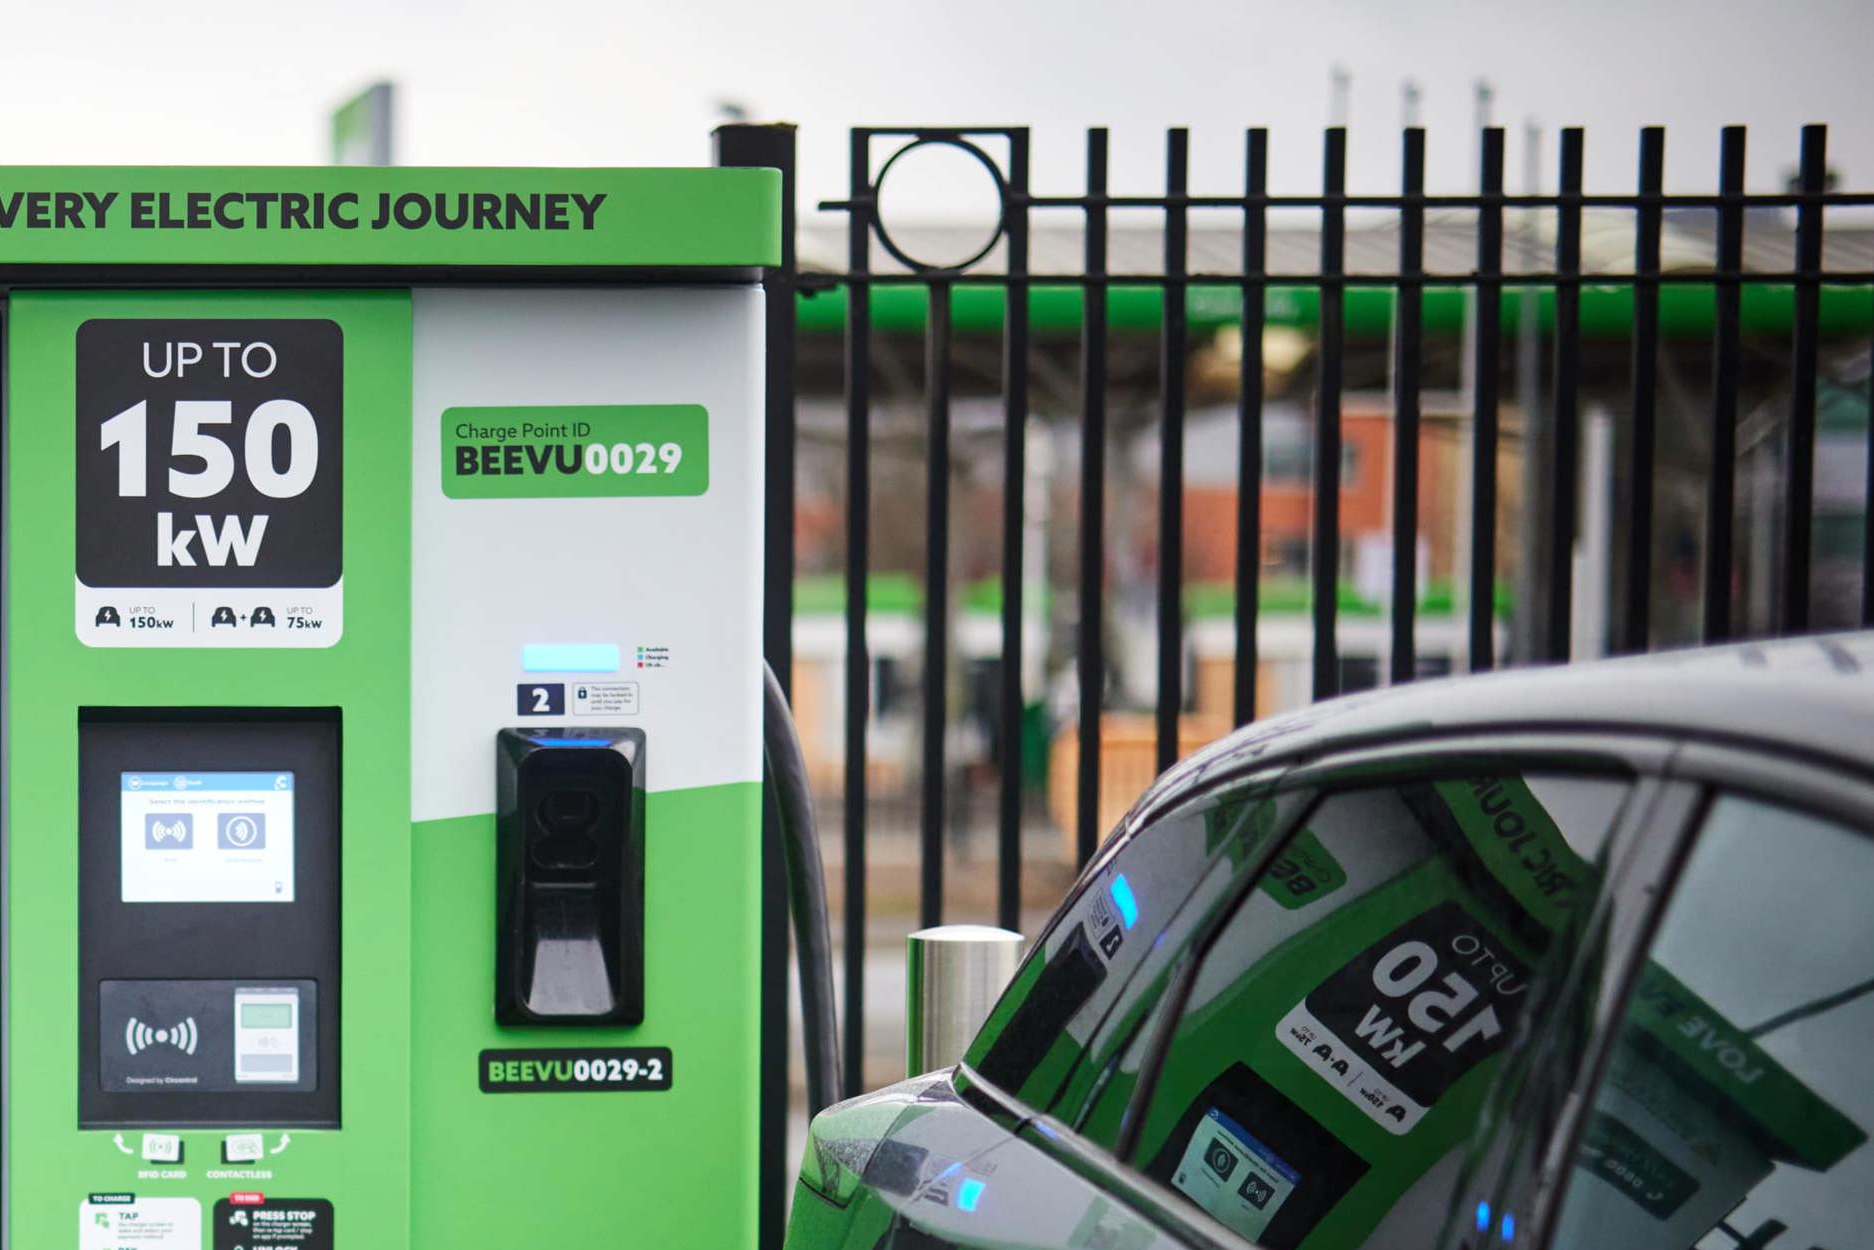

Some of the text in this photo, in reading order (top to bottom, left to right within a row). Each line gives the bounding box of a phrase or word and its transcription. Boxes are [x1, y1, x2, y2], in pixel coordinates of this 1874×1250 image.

[130, 192, 359, 230] ELECTRIC
[371, 193, 608, 231] JOURNEY
[143, 341, 277, 379] UP TO
[456, 422, 591, 442] Charge Point ID
[100, 399, 319, 499] 150
[455, 442, 683, 476] BEEVU0029
[157, 512, 269, 566] kW
[129, 617, 174, 629] 150kW
[287, 617, 323, 629] 75kW
[532, 688, 551, 712] 2
[488, 1059, 663, 1082] BEEVU0029-2
[138, 1170, 187, 1179] RFID CARD
[206, 1170, 272, 1179] CONTACTLESS
[119, 1212, 139, 1220] TAP
[252, 1211, 316, 1220] PRESS STOP
